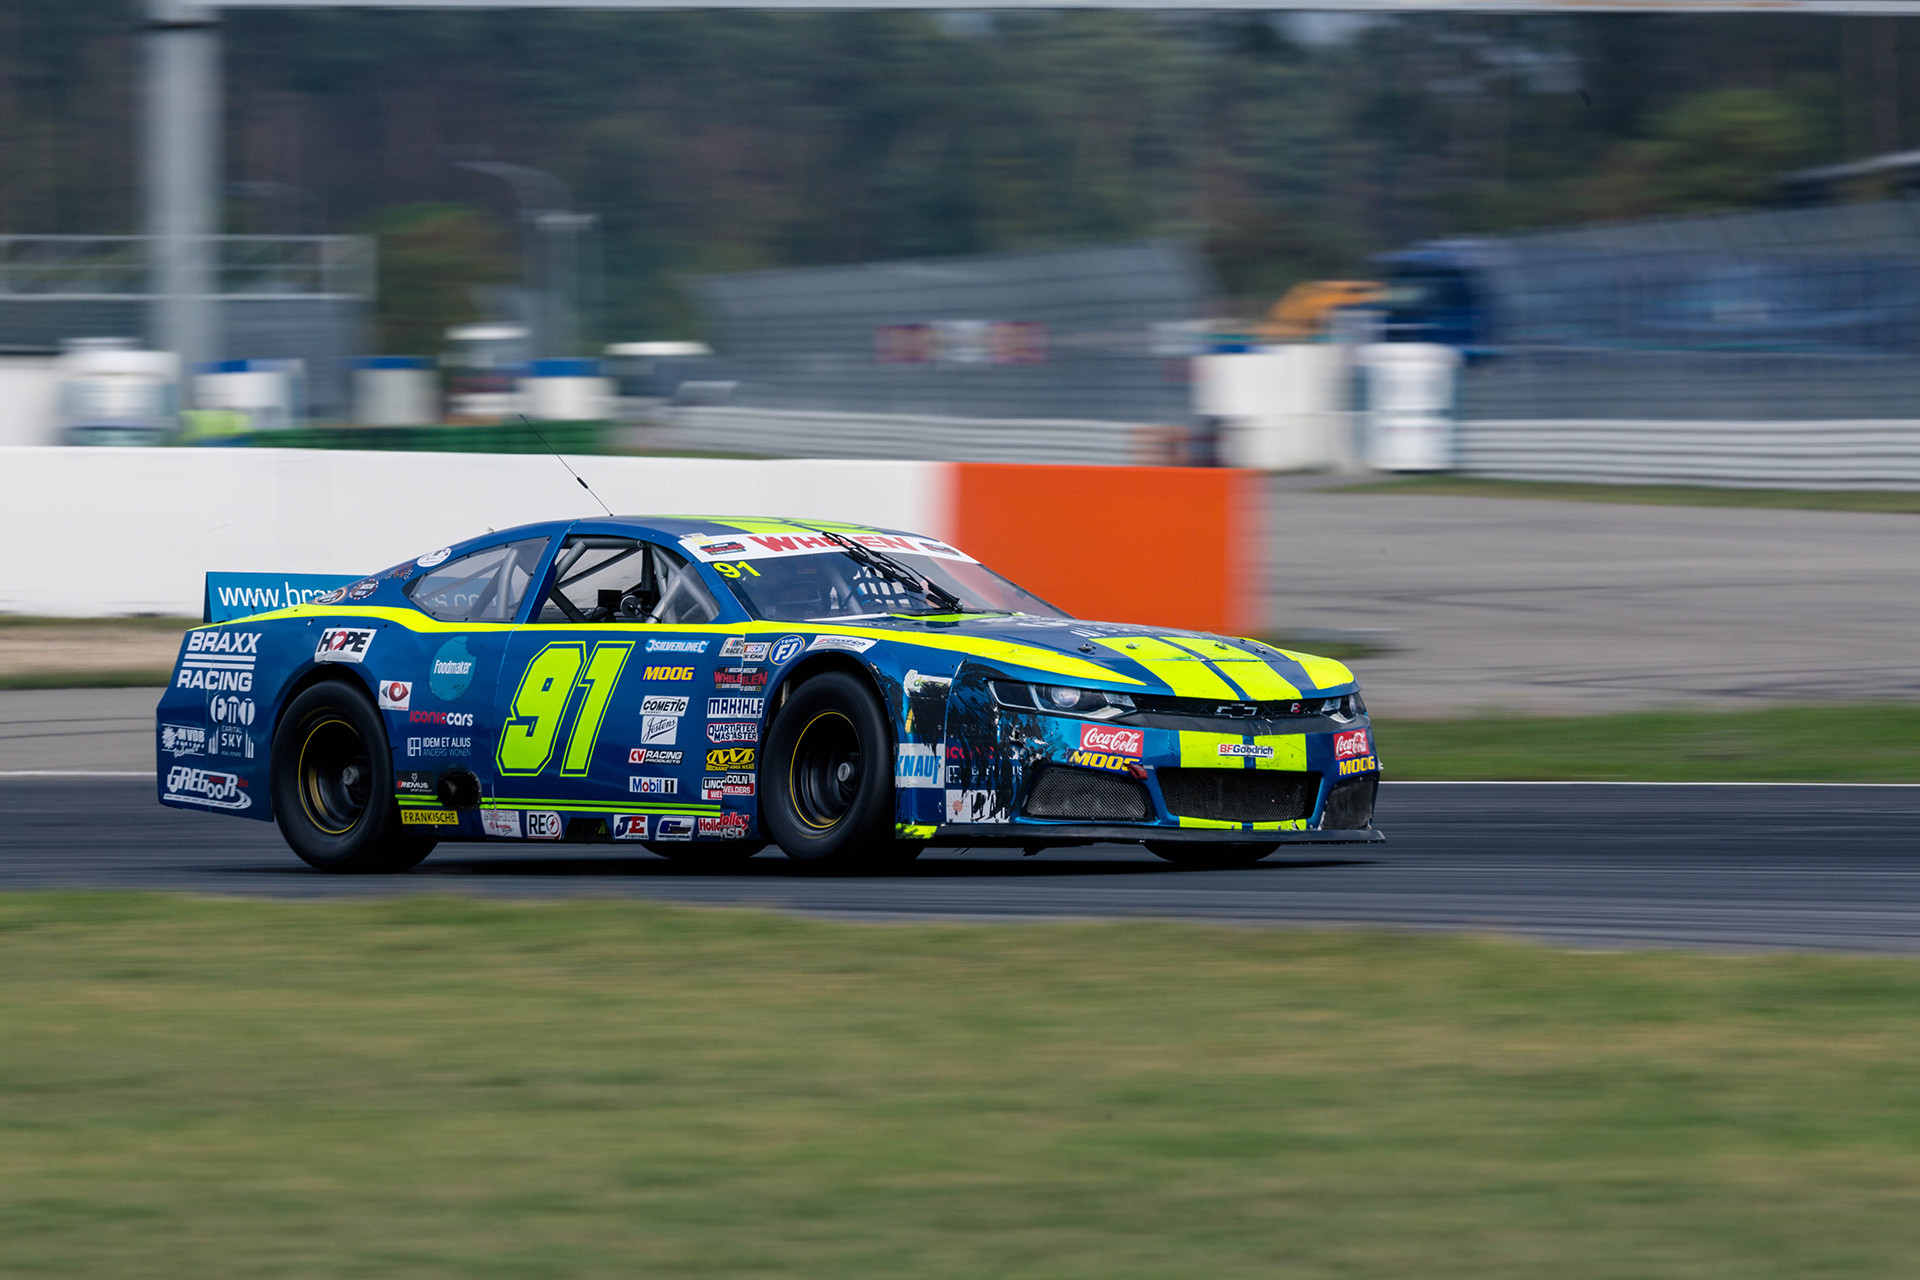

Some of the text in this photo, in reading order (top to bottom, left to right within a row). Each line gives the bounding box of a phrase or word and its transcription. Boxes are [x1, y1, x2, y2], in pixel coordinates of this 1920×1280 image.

[713, 561, 761, 578] 91
[187, 631, 262, 653] BRAXX
[317, 631, 371, 653] HOPE
[774, 642, 799, 661] FJ
[433, 659, 472, 675] Foodmaker
[643, 666, 695, 680] MOOG
[176, 669, 253, 692] RACING
[496, 641, 636, 777] 91
[643, 699, 686, 712] COMETIC
[221, 733, 243, 748] SKY
[423, 737, 471, 747] IDEM ET ALIUS
[1083, 727, 1141, 753] Coca-Cola
[1220, 744, 1273, 755] BFGoodrich
[1336, 732, 1367, 756] Coca-Cola
[631, 750, 682, 761] CV RACING
[1339, 756, 1375, 775] MOOG
[167, 765, 238, 799] GREGOOR
[632, 778, 662, 792] Mobil
[615, 816, 646, 837] JE
